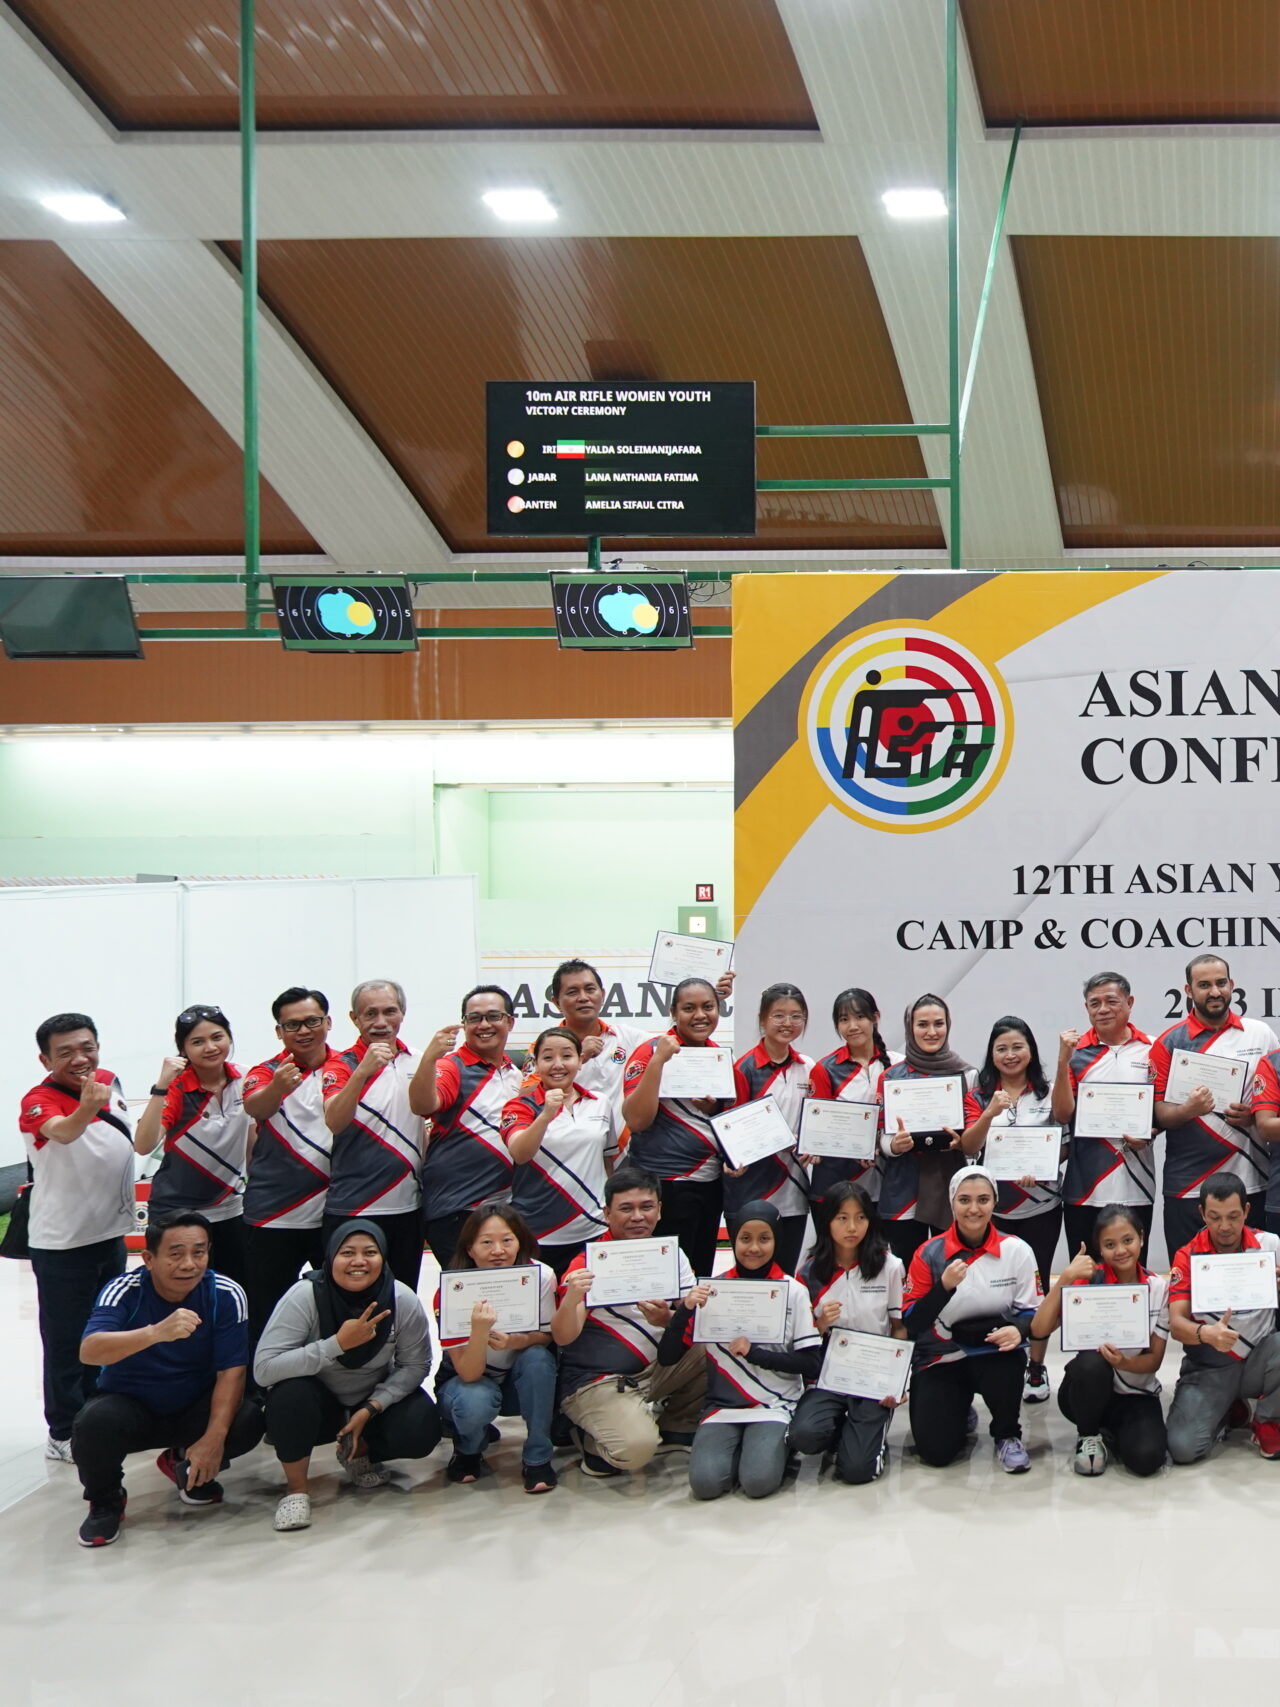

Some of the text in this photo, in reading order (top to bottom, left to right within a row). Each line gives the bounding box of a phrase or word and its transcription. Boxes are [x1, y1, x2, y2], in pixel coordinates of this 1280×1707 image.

[525, 390, 711, 402] 10m AIR RIFLE WOMEN YOUTH
[525, 405, 627, 416] VICTORY CEREMONY
[542, 445, 557, 454] IRI
[585, 445, 615, 455] YALDA
[527, 472, 699, 484] JABAR LANA NATHANIA FATIMA
[585, 500, 622, 510] AMELIA
[622, 500, 656, 510] SIFAUL
[656, 500, 685, 510] CITRA
[277, 608, 412, 617] 5 6 7 7 6 5
[556, 606, 563, 615] 5
[570, 606, 577, 615] 6
[583, 606, 590, 615] 7
[668, 606, 675, 615] 6
[682, 606, 689, 615] 5
[1013, 864, 1114, 895] 12TH
[1124, 862, 1256, 894] ASIAN
[699, 886, 711, 898] R1
[896, 919, 1024, 951] CAMP
[1034, 918, 1068, 950] &
[512, 982, 675, 1019] ASAN
[1164, 987, 1248, 1019] 23
